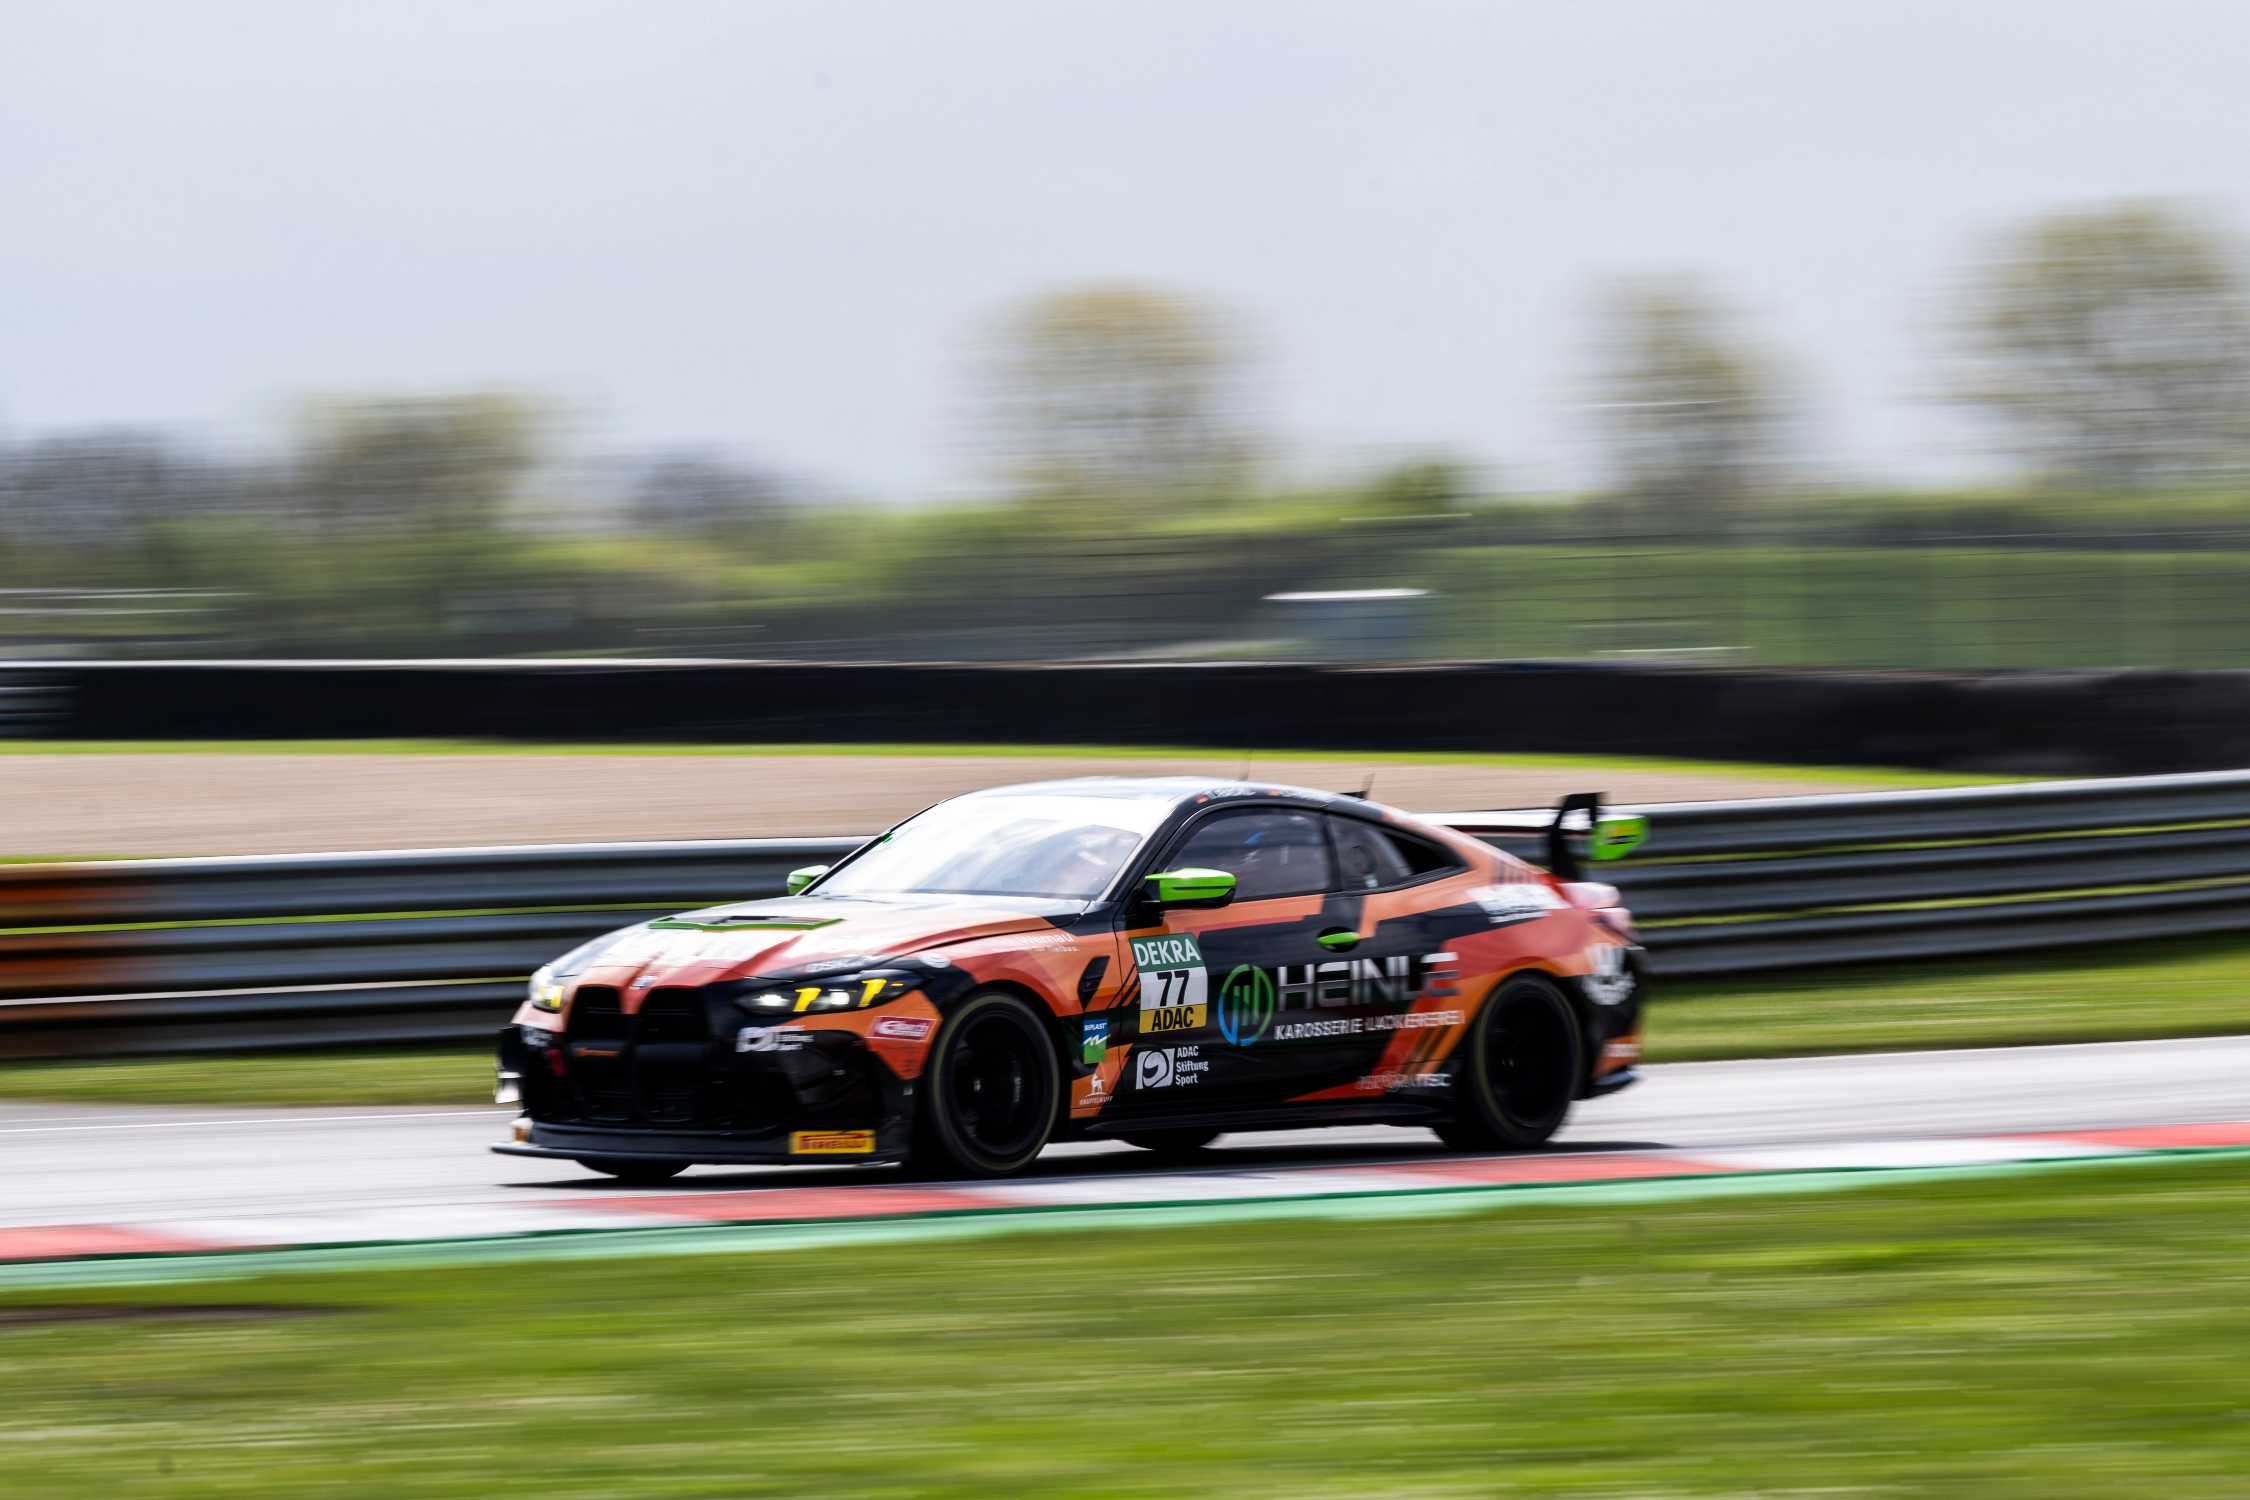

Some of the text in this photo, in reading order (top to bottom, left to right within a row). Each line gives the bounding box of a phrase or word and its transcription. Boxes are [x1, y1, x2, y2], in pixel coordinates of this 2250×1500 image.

[1133, 939, 1202, 967] DEKRA
[1156, 969, 1190, 1007] 77
[1277, 952, 1461, 1012] HEINLE
[1151, 1006, 1194, 1031] ADAC
[1274, 1018, 1364, 1041] KAROSSERIE
[1176, 1045, 1199, 1058] ADAC
[1175, 1060, 1209, 1073] Stiftung
[1175, 1073, 1199, 1087] Sport
